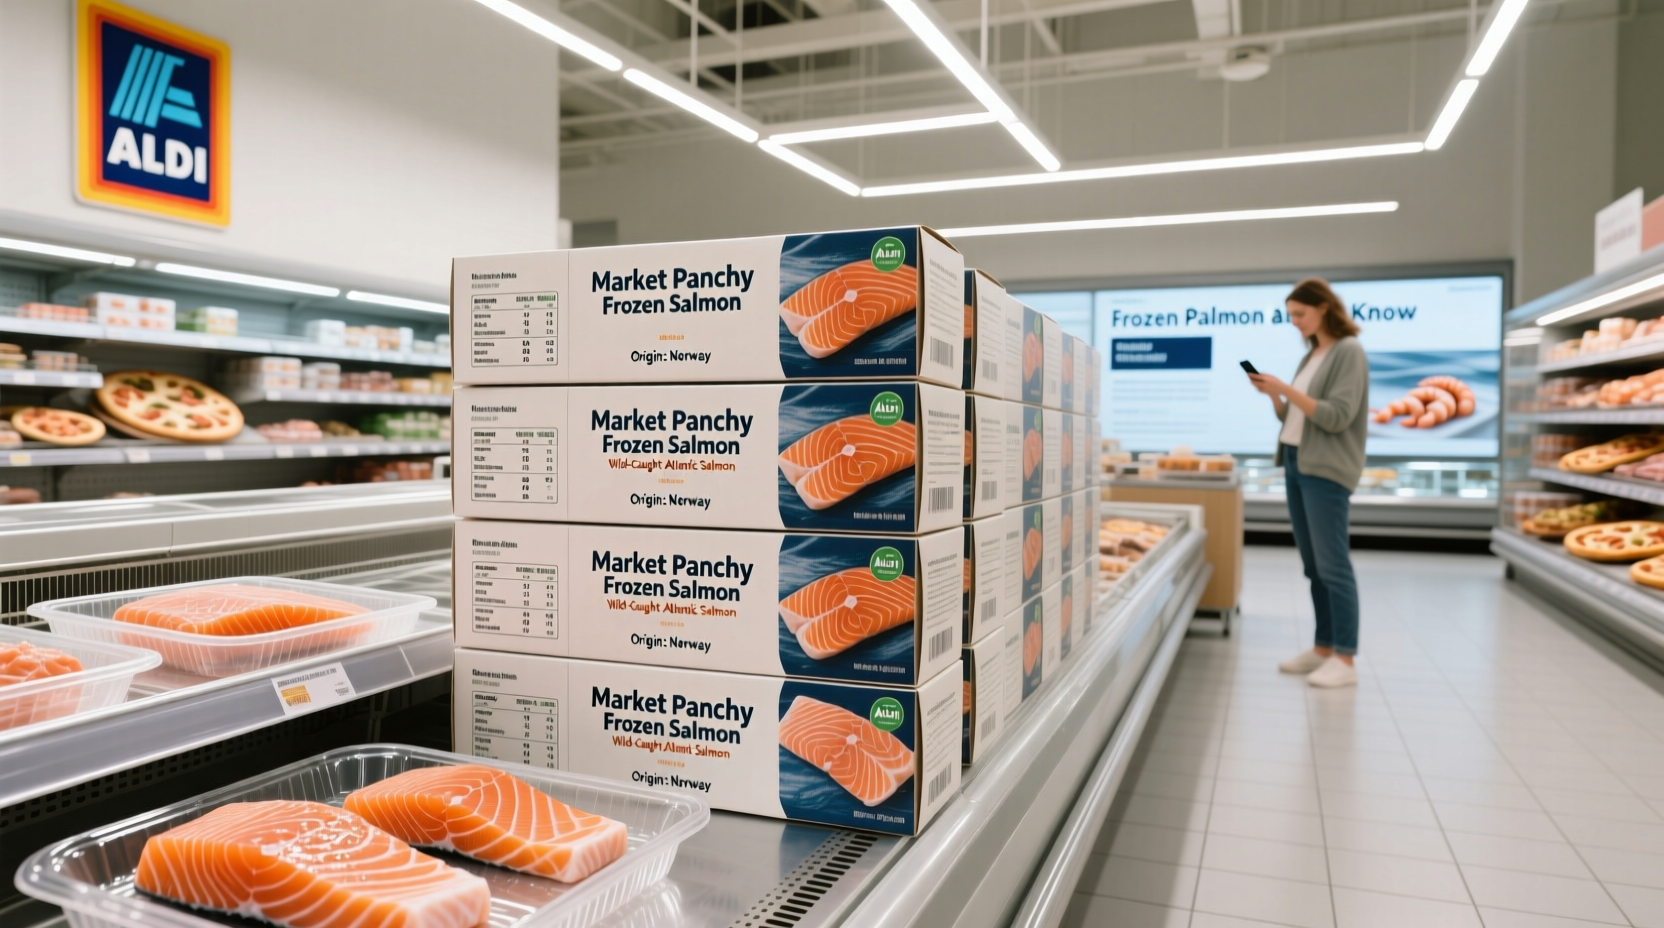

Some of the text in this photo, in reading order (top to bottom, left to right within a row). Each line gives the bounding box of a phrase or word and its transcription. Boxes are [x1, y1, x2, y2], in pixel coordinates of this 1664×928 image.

[106, 126, 207, 185] ALDI
[591, 263, 755, 293] Market Panchy
[602, 291, 742, 315] Frozen Salmon
[1112, 309, 1178, 327] Frozen
[1186, 306, 1264, 326] Palmon
[1353, 303, 1417, 321] Know
[630, 350, 668, 366] Origin:
[591, 407, 754, 438] Market Panchy
[602, 434, 741, 455] Frozen Salmon
[630, 493, 667, 508] Origin:
[591, 550, 754, 586] Market Panchy
[603, 575, 741, 602] Frozen Salmon
[630, 633, 667, 650] Origin:
[591, 685, 754, 729] Market Panchy
[603, 712, 741, 745] Frozen Salmon
[631, 770, 669, 787] Origin:
